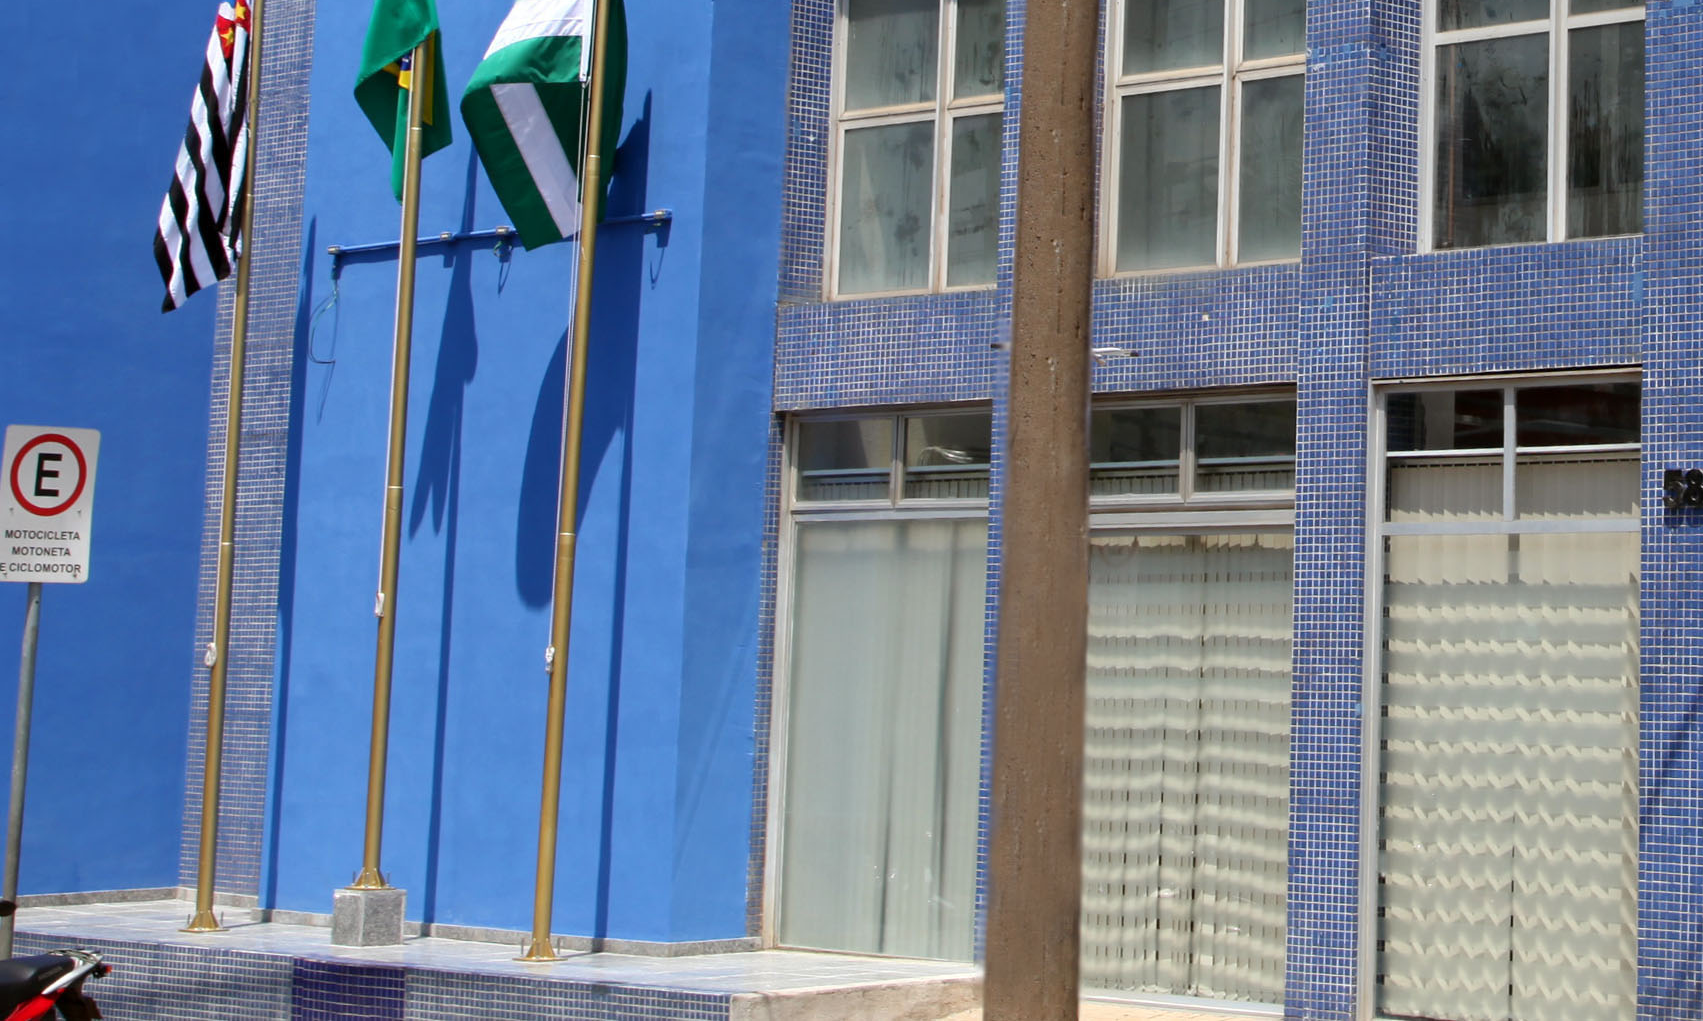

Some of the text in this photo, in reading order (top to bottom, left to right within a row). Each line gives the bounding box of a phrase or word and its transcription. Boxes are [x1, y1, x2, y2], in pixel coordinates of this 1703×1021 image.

[34, 453, 62, 497] E
[5, 530, 81, 540] MOTOCICLETA
[11, 546, 71, 557] MOTONETA
[9, 562, 81, 574] CICLOMOTOR
